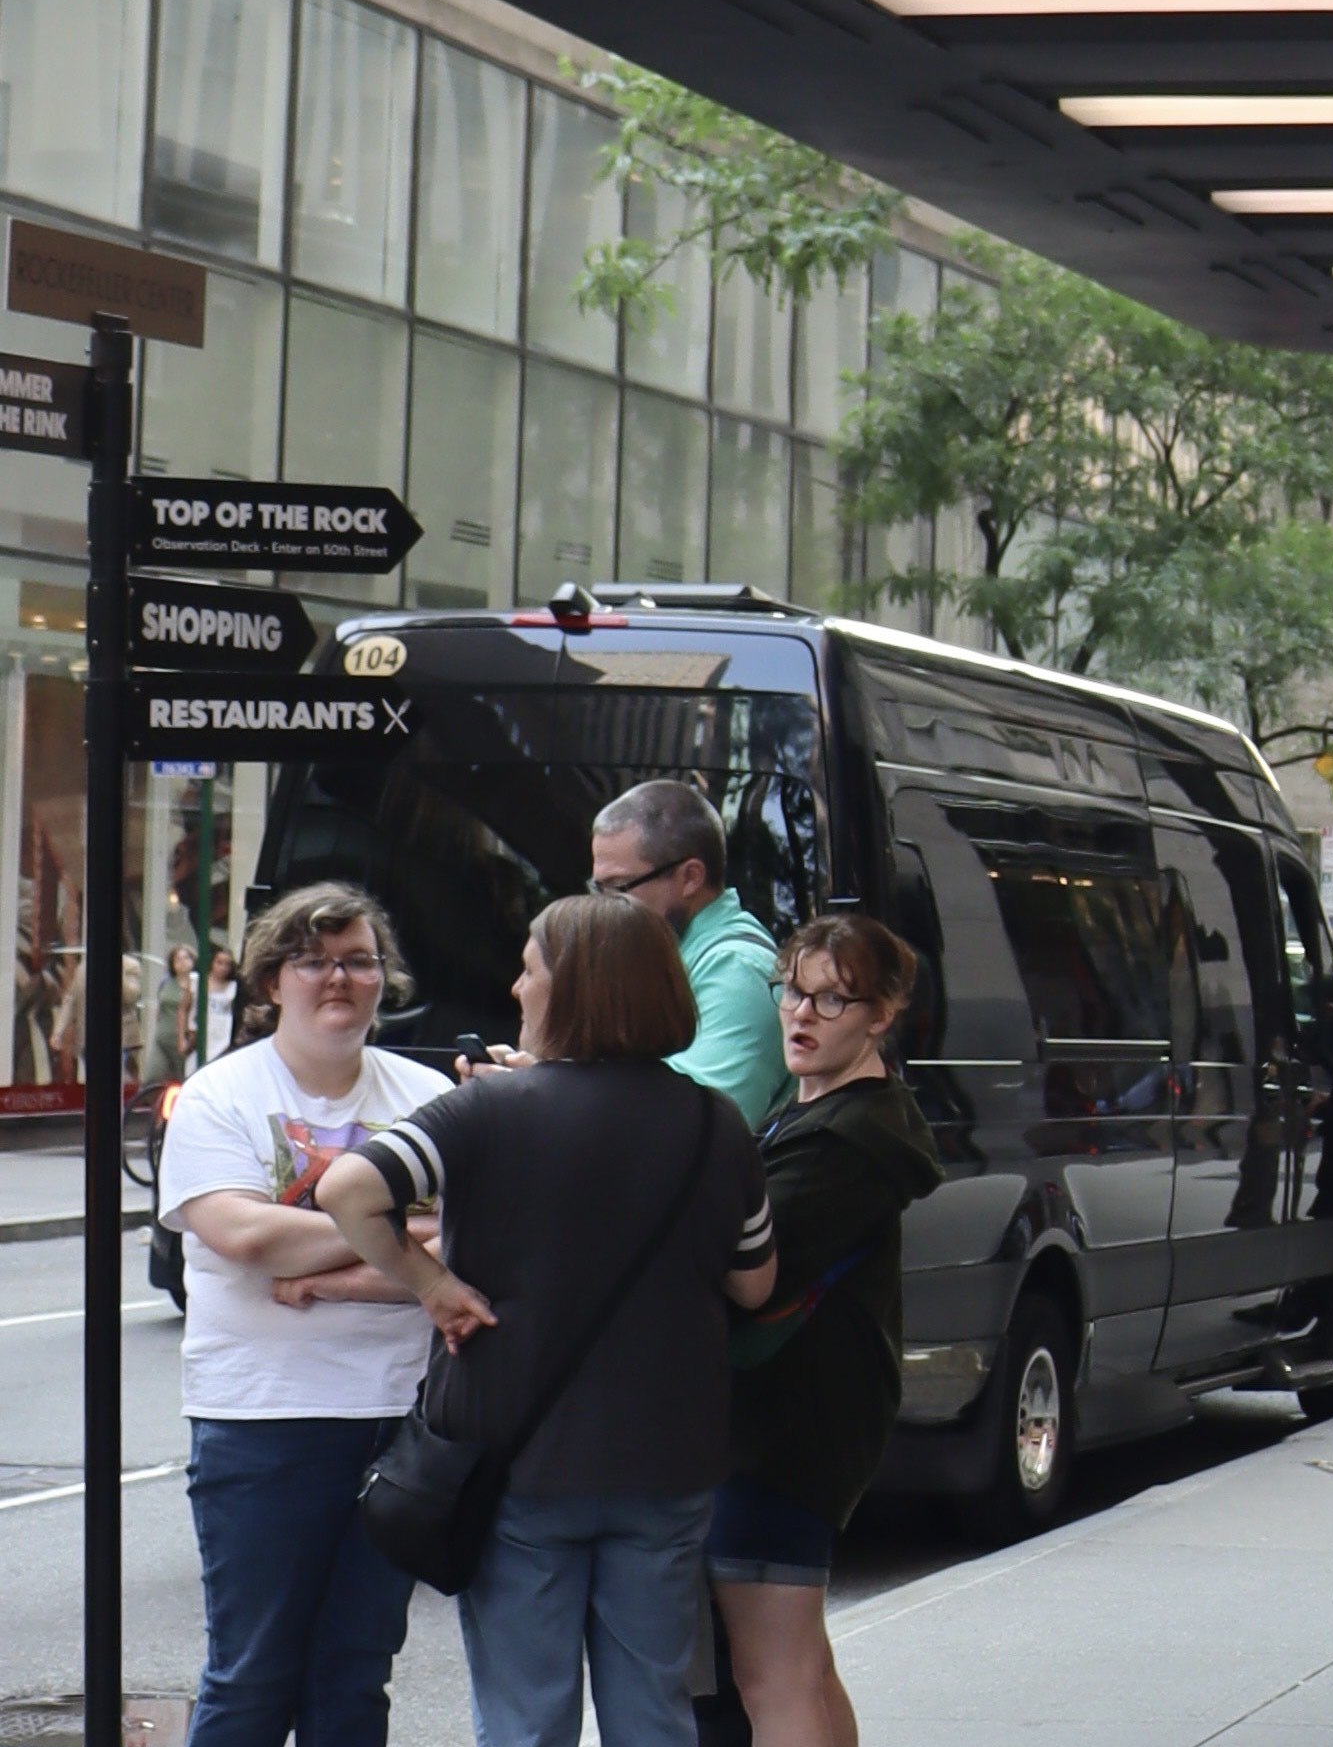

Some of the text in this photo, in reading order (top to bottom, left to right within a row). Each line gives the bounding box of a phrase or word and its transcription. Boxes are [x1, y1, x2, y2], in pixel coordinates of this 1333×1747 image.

[24, 408, 67, 440] RINK
[153, 499, 388, 534] TOP OF THE ROCK
[152, 537, 228, 552] Observation
[231, 540, 260, 553] Deck
[272, 541, 303, 554] Enter
[354, 545, 388, 558] Street
[142, 603, 282, 652] SHOPPING
[352, 646, 400, 671] 104
[150, 699, 375, 730] RESTAURANTS
